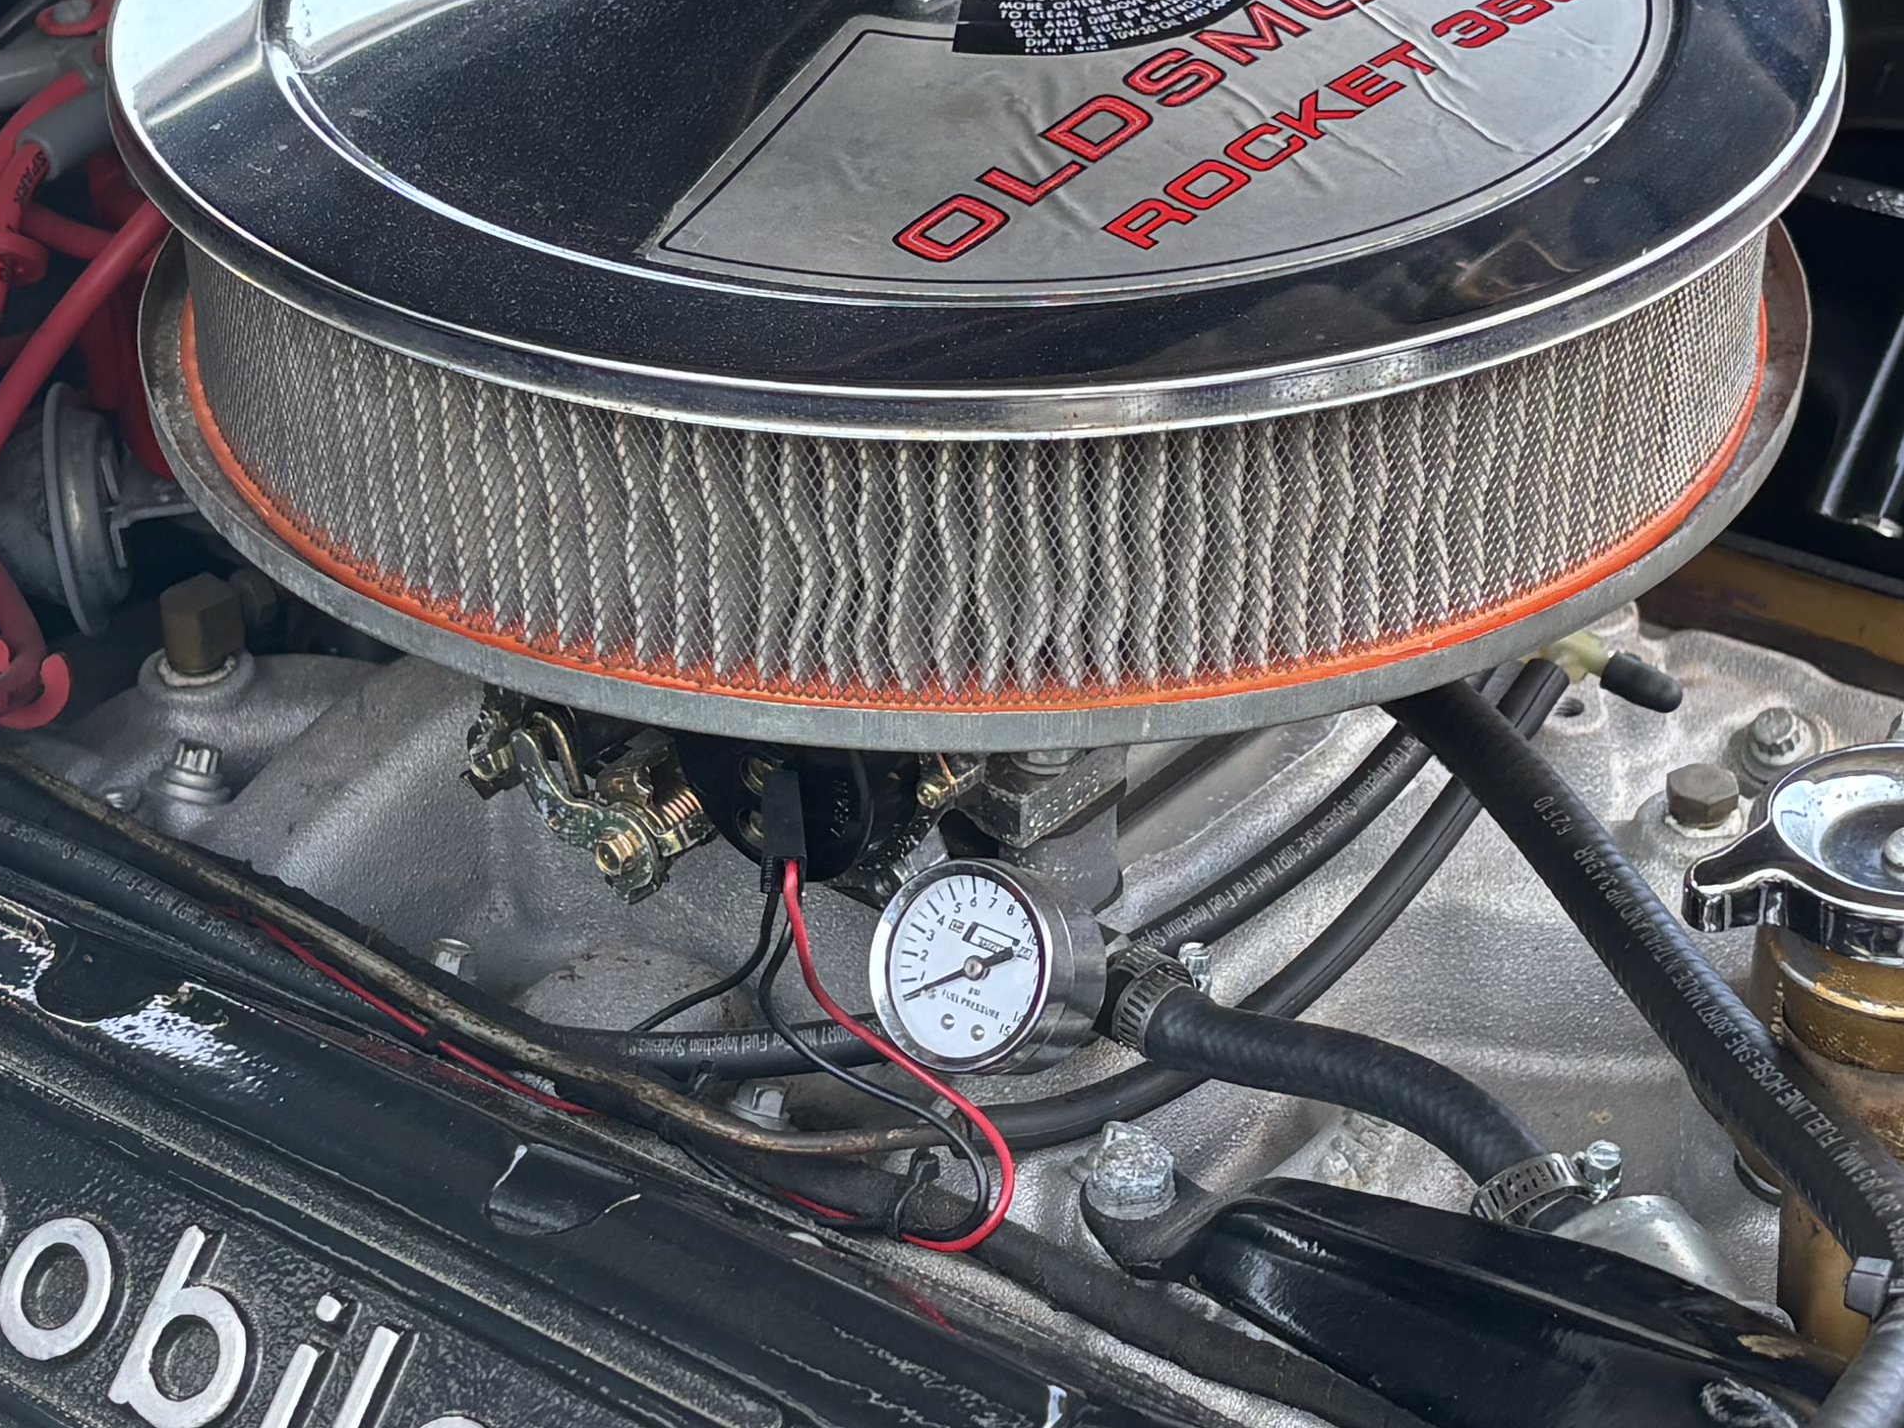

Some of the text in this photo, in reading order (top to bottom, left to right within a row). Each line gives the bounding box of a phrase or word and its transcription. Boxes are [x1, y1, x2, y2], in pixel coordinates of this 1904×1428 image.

[998, 0, 1044, 11] MORE
[1000, 9, 1022, 20] TO
[1009, 20, 1035, 29] OIL
[1043, 18, 1080, 29] AND
[1087, 13, 1118, 26] DIRT
[1124, 7, 1141, 18] BY
[1015, 26, 1084, 39] SOLVENT
[1090, 21, 1134, 35] SUCH
[1141, 13, 1161, 26] AS
[1025, 38, 1051, 49] DIP
[1076, 35, 1107, 47] SAE
[1109, 24, 1159, 42] 10W30
[1159, 16, 1183, 31] OIL
[1183, 7, 1211, 23] AND
[1102, 43, 1438, 252] ROCKET
[1295, 828, 1322, 854] SAE
[1270, 843, 1302, 873] 30R7
[1231, 877, 1255, 901] For
[1249, 864, 1274, 888] Not
[936, 914, 946, 927] 4
[952, 902, 963, 914] 5
[969, 896, 978, 908] 6
[988, 897, 998, 909] 7
[1006, 903, 1015, 916] 8
[1206, 888, 1236, 917] Fuel
[925, 929, 936, 942] 3
[1160, 899, 1211, 944] Injection
[1620, 896, 1678, 965] THAILAND
[919, 949, 929, 963] 2
[1672, 964, 1712, 1009] MADE
[941, 988, 962, 1005] FUEL
[960, 997, 1001, 1021] PRESSURE
[1700, 995, 1742, 1041] J30R7
[740, 1033, 768, 1054] Fuel
[998, 1022, 1013, 1037] 15
[639, 1036, 686, 1058] Systems
[687, 1035, 740, 1057] Injection
[1731, 1028, 1764, 1062] SAE
[1752, 1051, 1792, 1095] HOSE
[1781, 1083, 1819, 1123] LINE
[1804, 1109, 1843, 1151] FUEL
